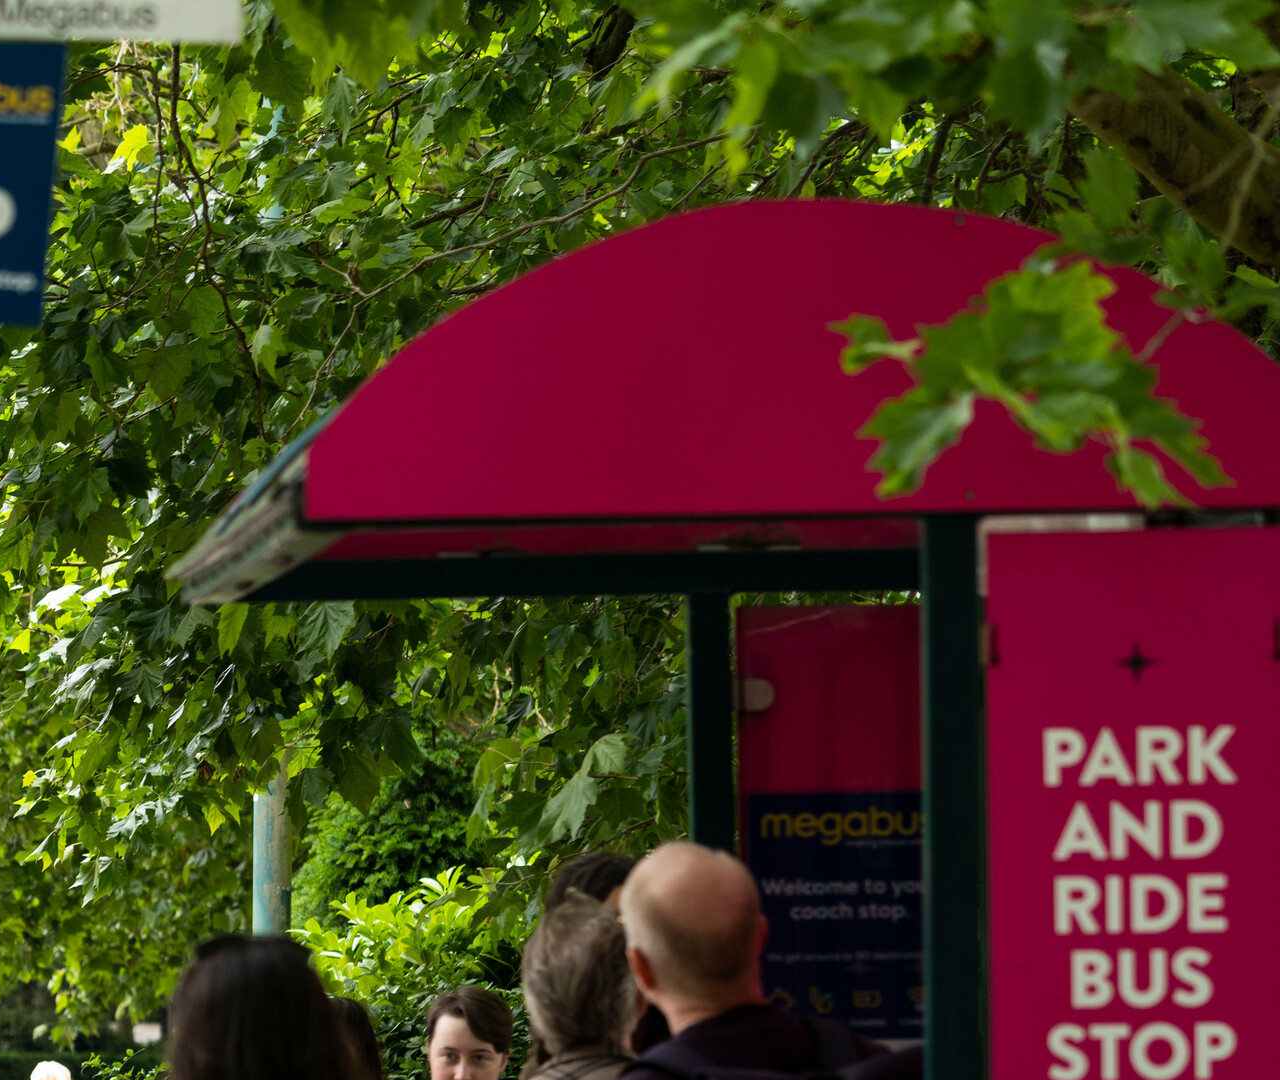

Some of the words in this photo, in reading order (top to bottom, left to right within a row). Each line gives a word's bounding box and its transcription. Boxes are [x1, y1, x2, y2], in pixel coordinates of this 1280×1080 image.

[1042, 724, 1238, 788] PARK
[1052, 798, 1224, 861] AND
[761, 878, 858, 897] Welcome
[864, 878, 886, 896] to
[790, 902, 852, 921] coach
[1053, 873, 1229, 935] RIDE
[1070, 947, 1214, 1009] BUS
